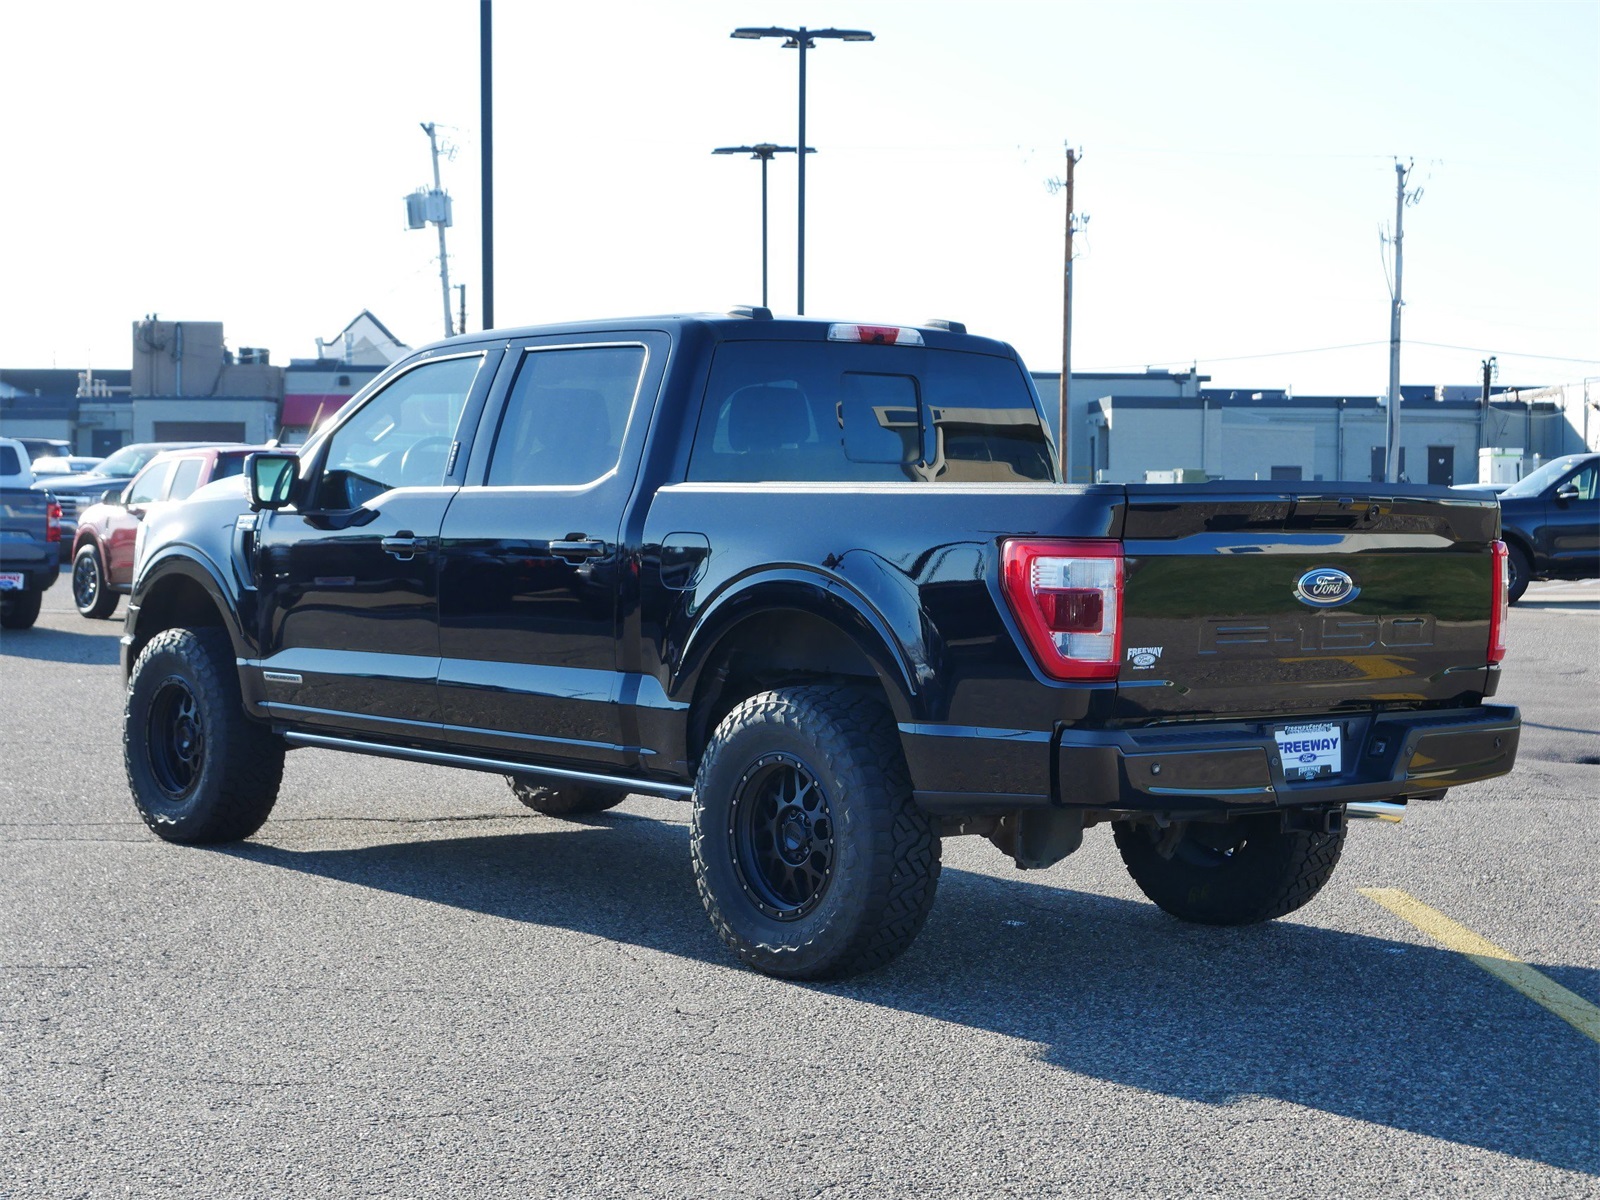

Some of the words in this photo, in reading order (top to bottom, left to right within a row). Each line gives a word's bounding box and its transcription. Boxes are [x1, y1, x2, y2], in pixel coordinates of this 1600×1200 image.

[1313, 576, 1343, 595] Ford
[1198, 614, 1436, 655] F-150
[1127, 646, 1163, 661] FREEWAY
[1278, 738, 1338, 753] FREEWAY
